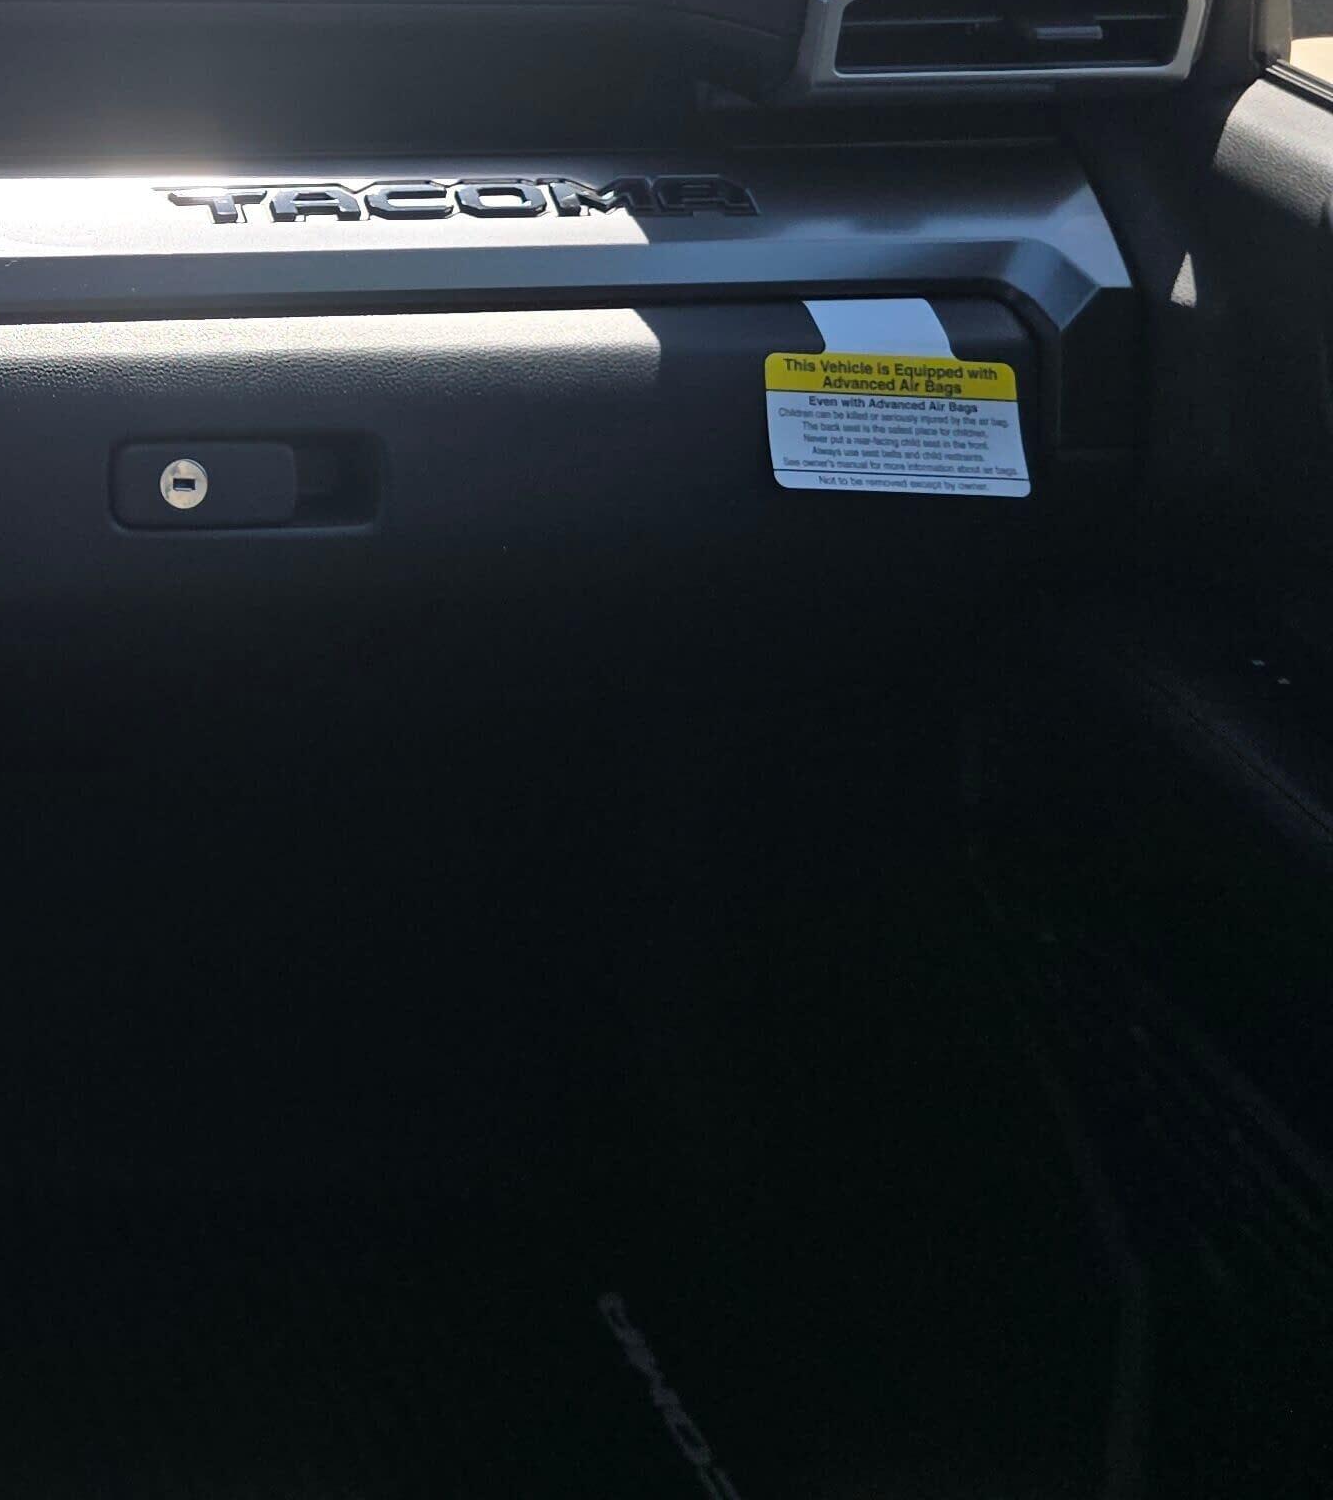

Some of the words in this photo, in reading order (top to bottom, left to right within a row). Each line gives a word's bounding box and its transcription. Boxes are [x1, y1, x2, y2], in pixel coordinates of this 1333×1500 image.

[151, 174, 761, 224] TACOMA
[783, 358, 815, 373] This
[820, 360, 873, 375] Vehicle
[877, 363, 890, 376] is
[895, 363, 964, 383] Equipped
[967, 366, 998, 381] with
[822, 376, 896, 392] Advanced
[899, 378, 920, 393] Air
[924, 380, 962, 396] Bags
[808, 396, 838, 407] Even
[841, 398, 866, 408] with
[868, 399, 926, 411] Advanced
[929, 401, 946, 411] Air
[948, 402, 978, 415] Bags
